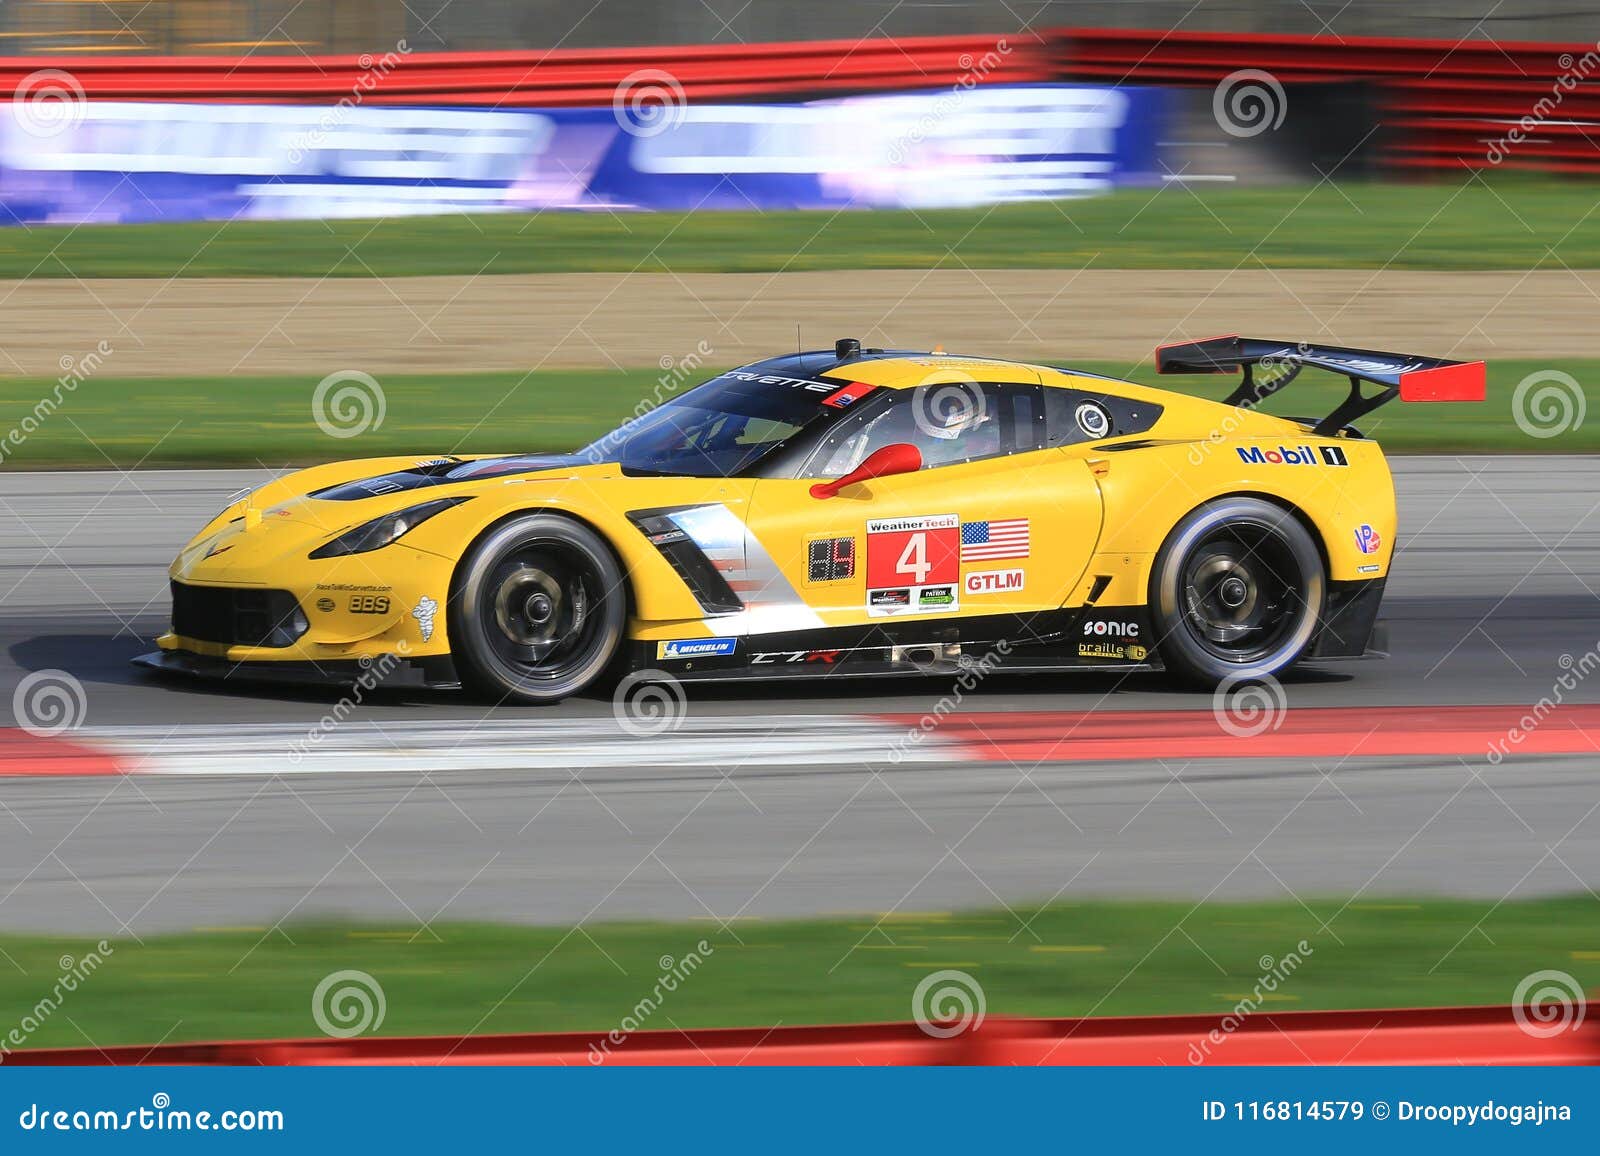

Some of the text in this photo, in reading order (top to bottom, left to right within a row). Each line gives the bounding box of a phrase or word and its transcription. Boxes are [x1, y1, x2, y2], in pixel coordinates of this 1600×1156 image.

[1235, 446, 1318, 465] Mobil
[870, 517, 955, 531] WeatherTech
[895, 532, 932, 583] 4
[967, 572, 1022, 591] GTLM
[349, 595, 391, 614] BBS
[679, 642, 729, 653] MICHELIN
[1078, 643, 1124, 653] braille
